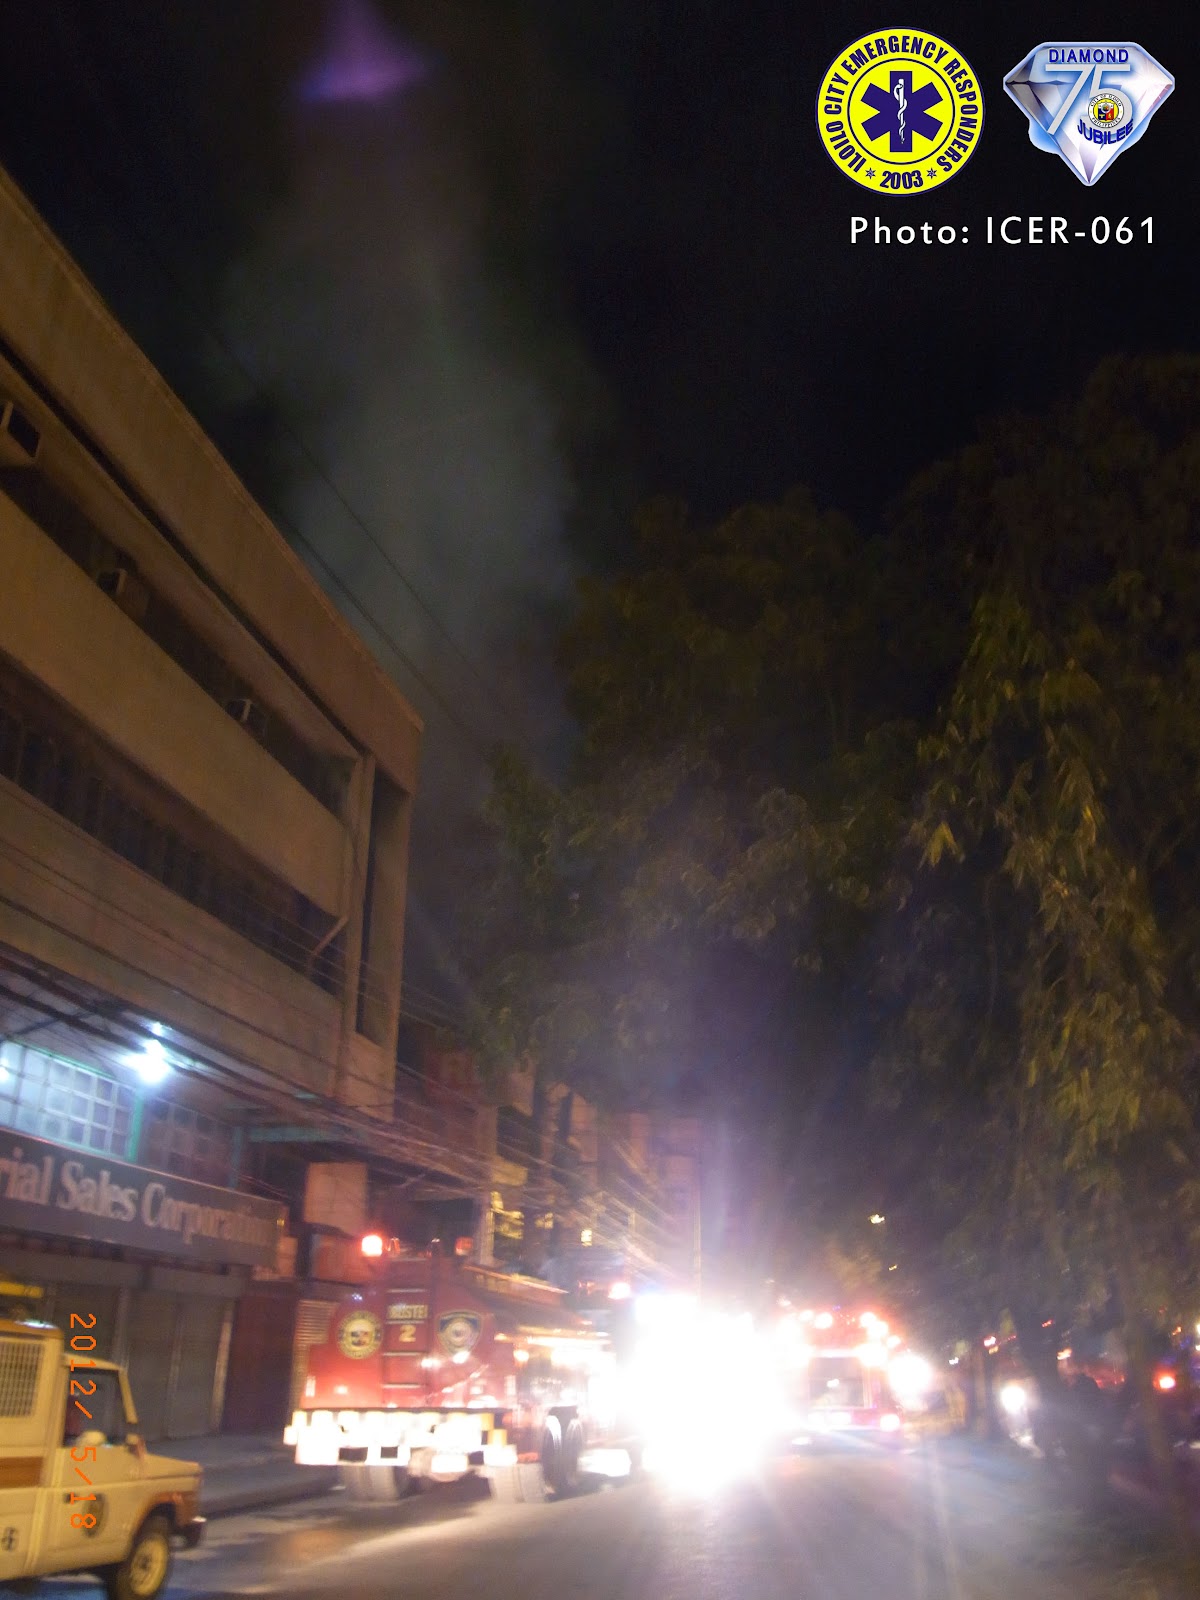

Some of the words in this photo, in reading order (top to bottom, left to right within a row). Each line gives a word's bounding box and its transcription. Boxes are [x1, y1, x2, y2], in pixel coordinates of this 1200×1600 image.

[56, 1160, 138, 1222] Sales
[141, 1182, 277, 1247] Corpora
[399, 1324, 417, 1342] 2
